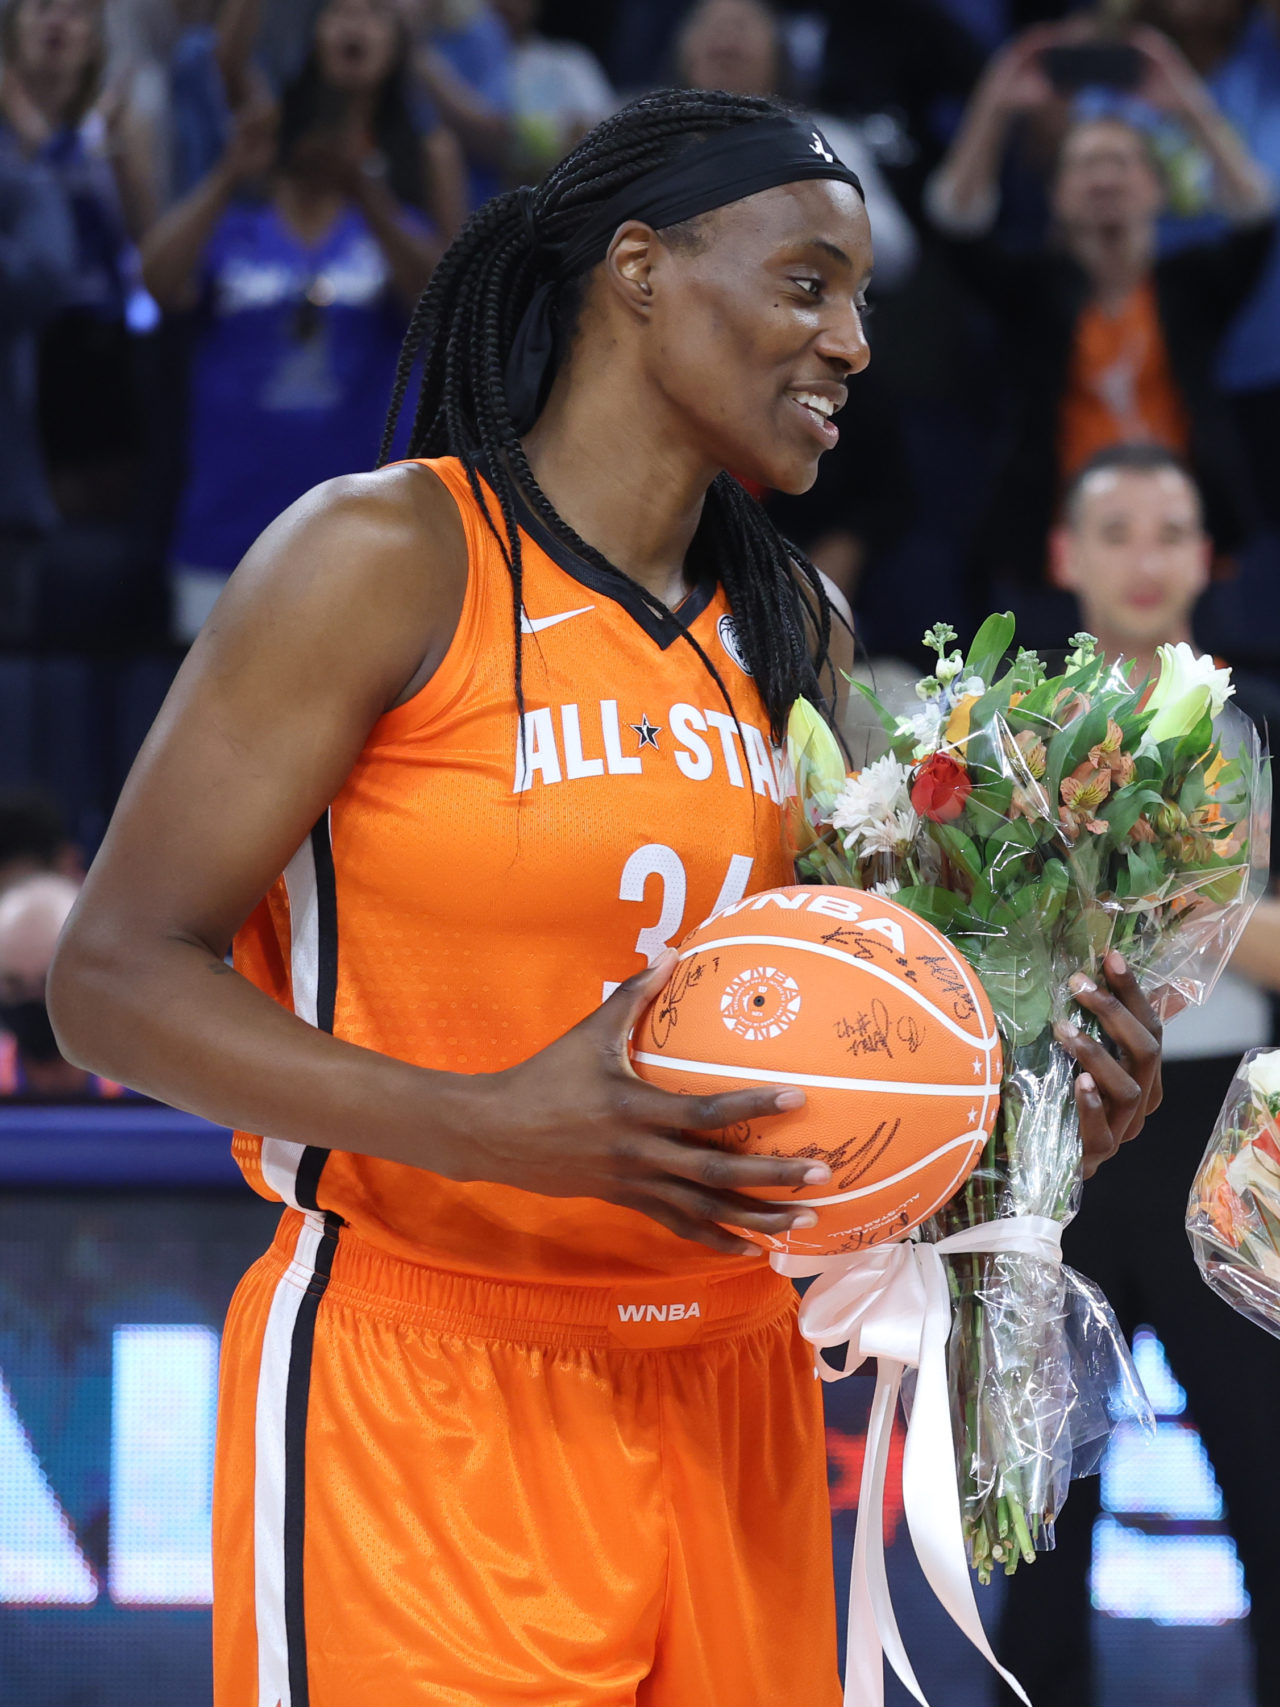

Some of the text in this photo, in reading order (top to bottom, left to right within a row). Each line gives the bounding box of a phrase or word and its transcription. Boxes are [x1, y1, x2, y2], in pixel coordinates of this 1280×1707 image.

[513, 700, 643, 794] ALL
[699, 893, 906, 955] WNBA
[617, 1302, 700, 1322] WNBA
